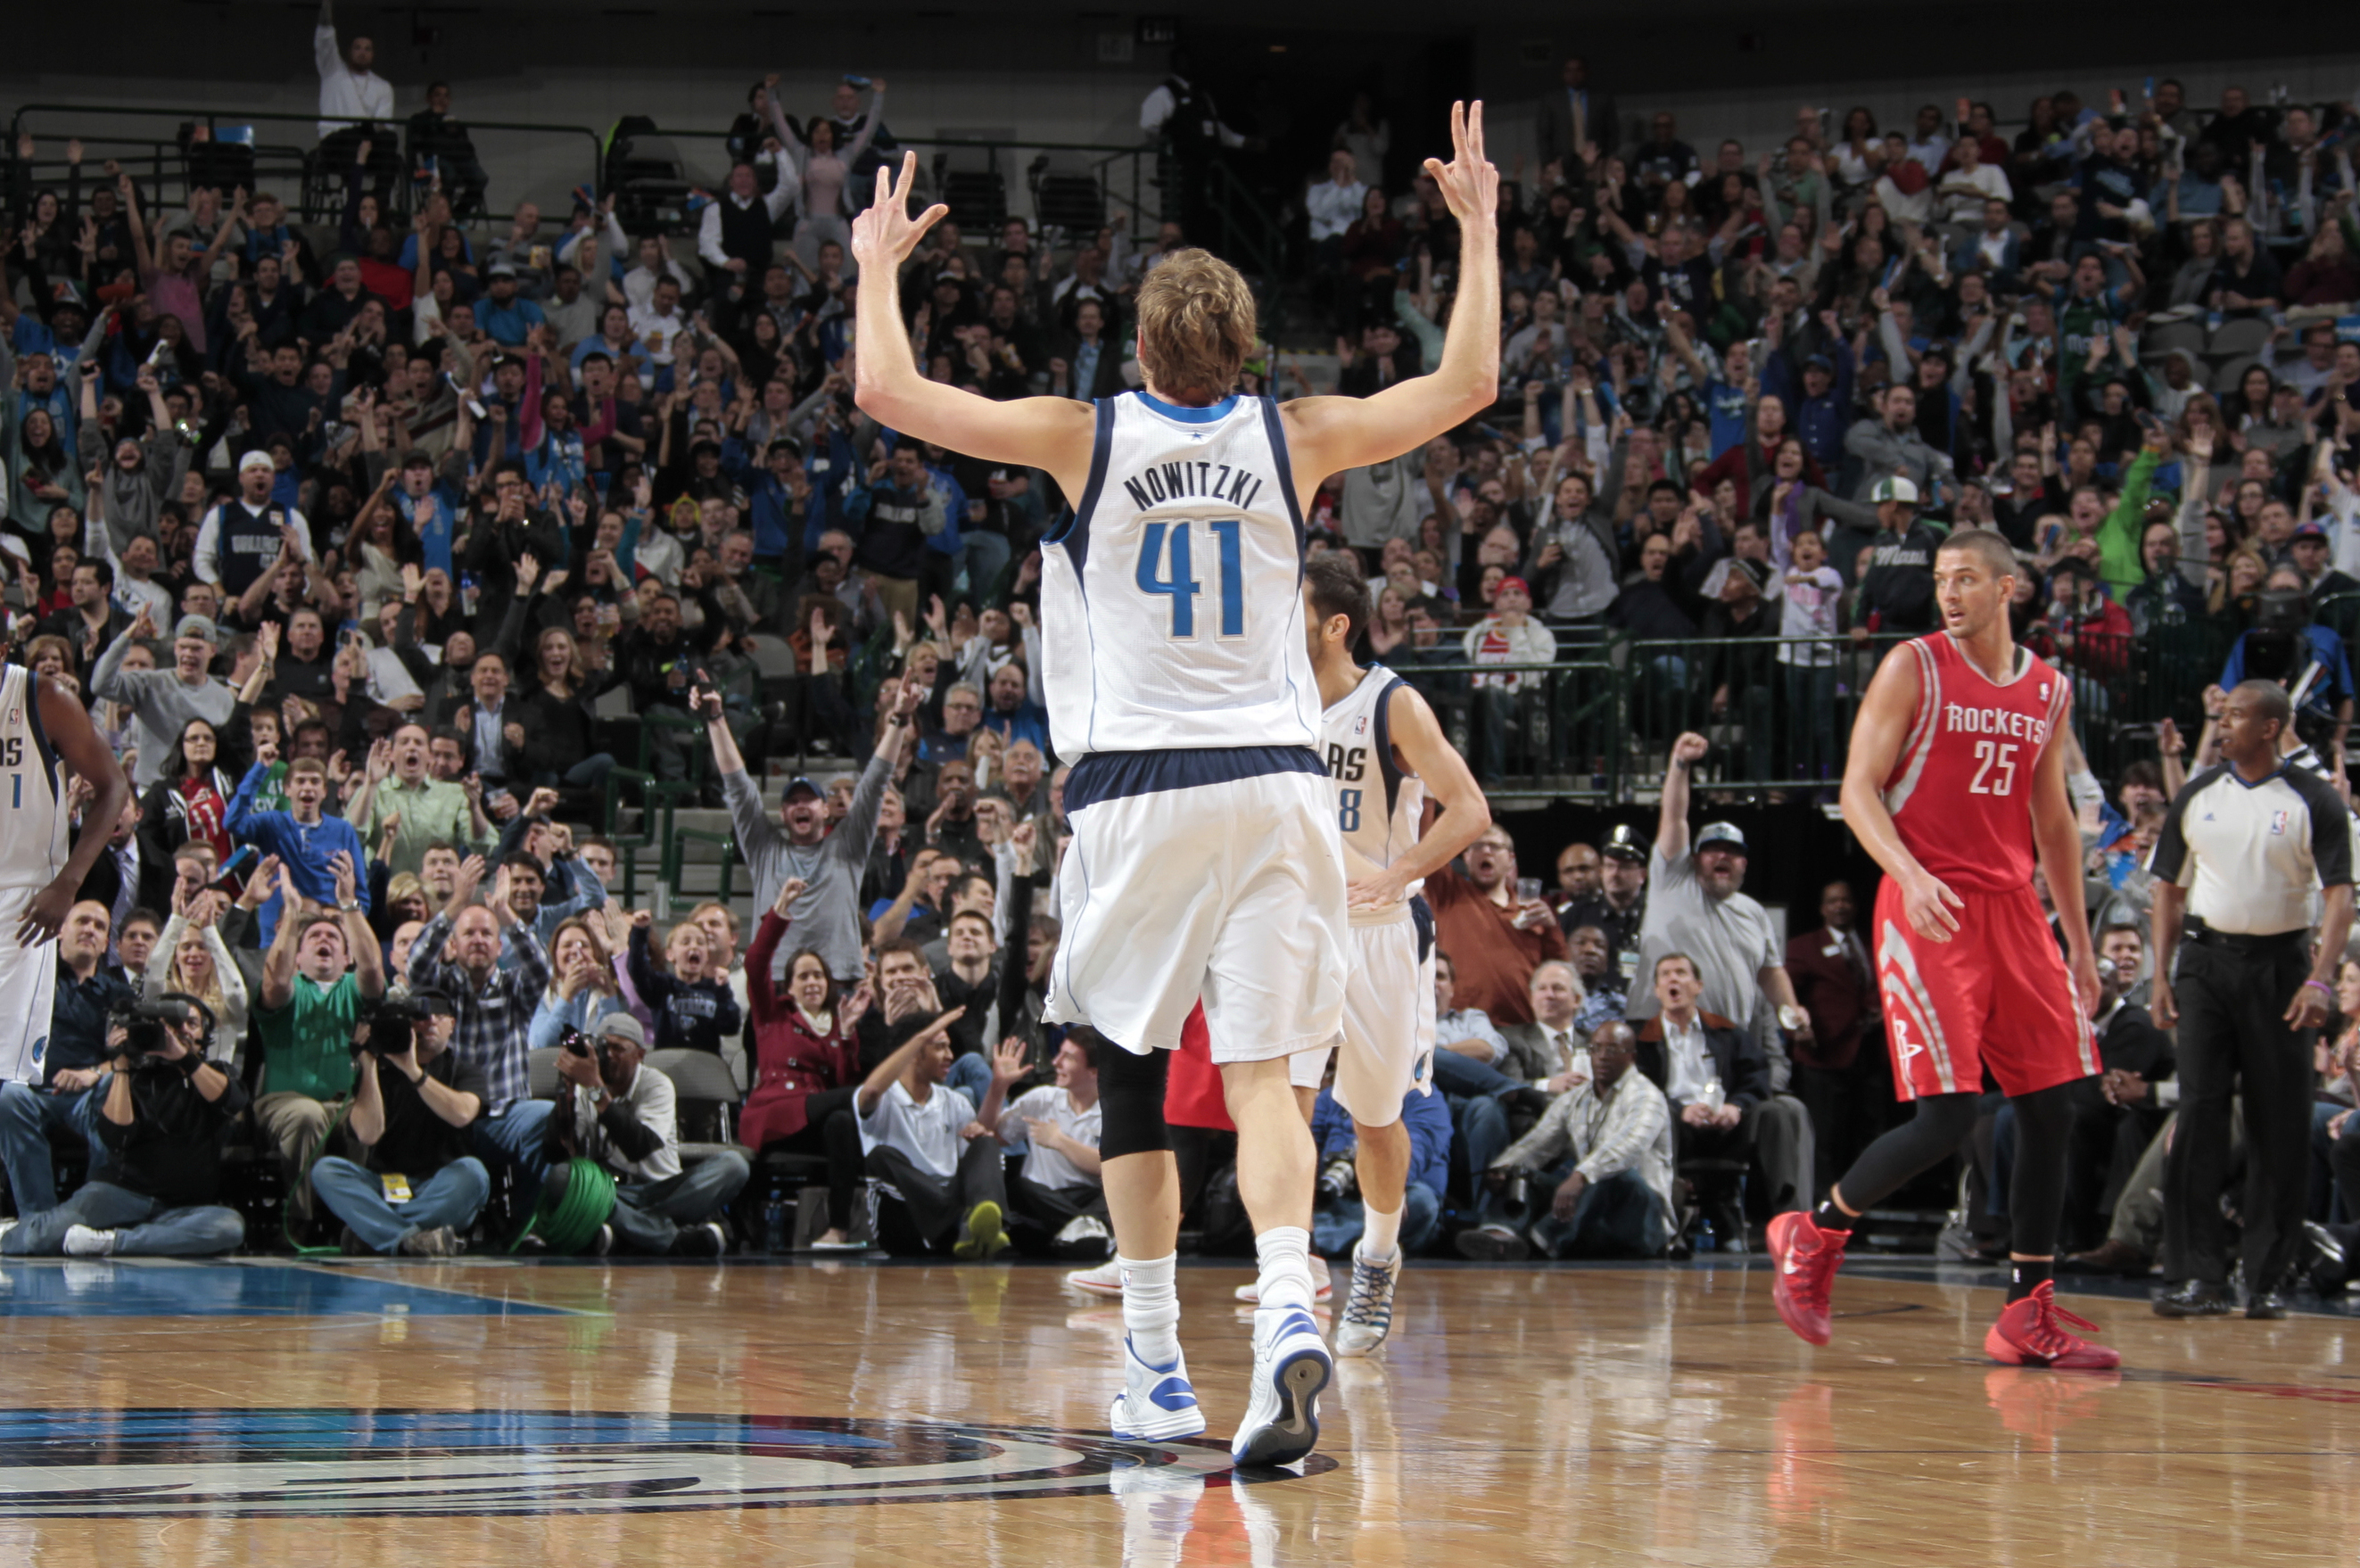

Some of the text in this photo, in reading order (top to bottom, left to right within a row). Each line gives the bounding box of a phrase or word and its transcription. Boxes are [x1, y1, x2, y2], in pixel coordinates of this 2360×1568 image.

[1124, 461, 1263, 512] NOWITZKI
[1133, 517, 1248, 641] 41
[1943, 701, 2046, 745] ROCKETS
[1969, 739, 2018, 796] 25
[1340, 788, 1363, 832] 8
